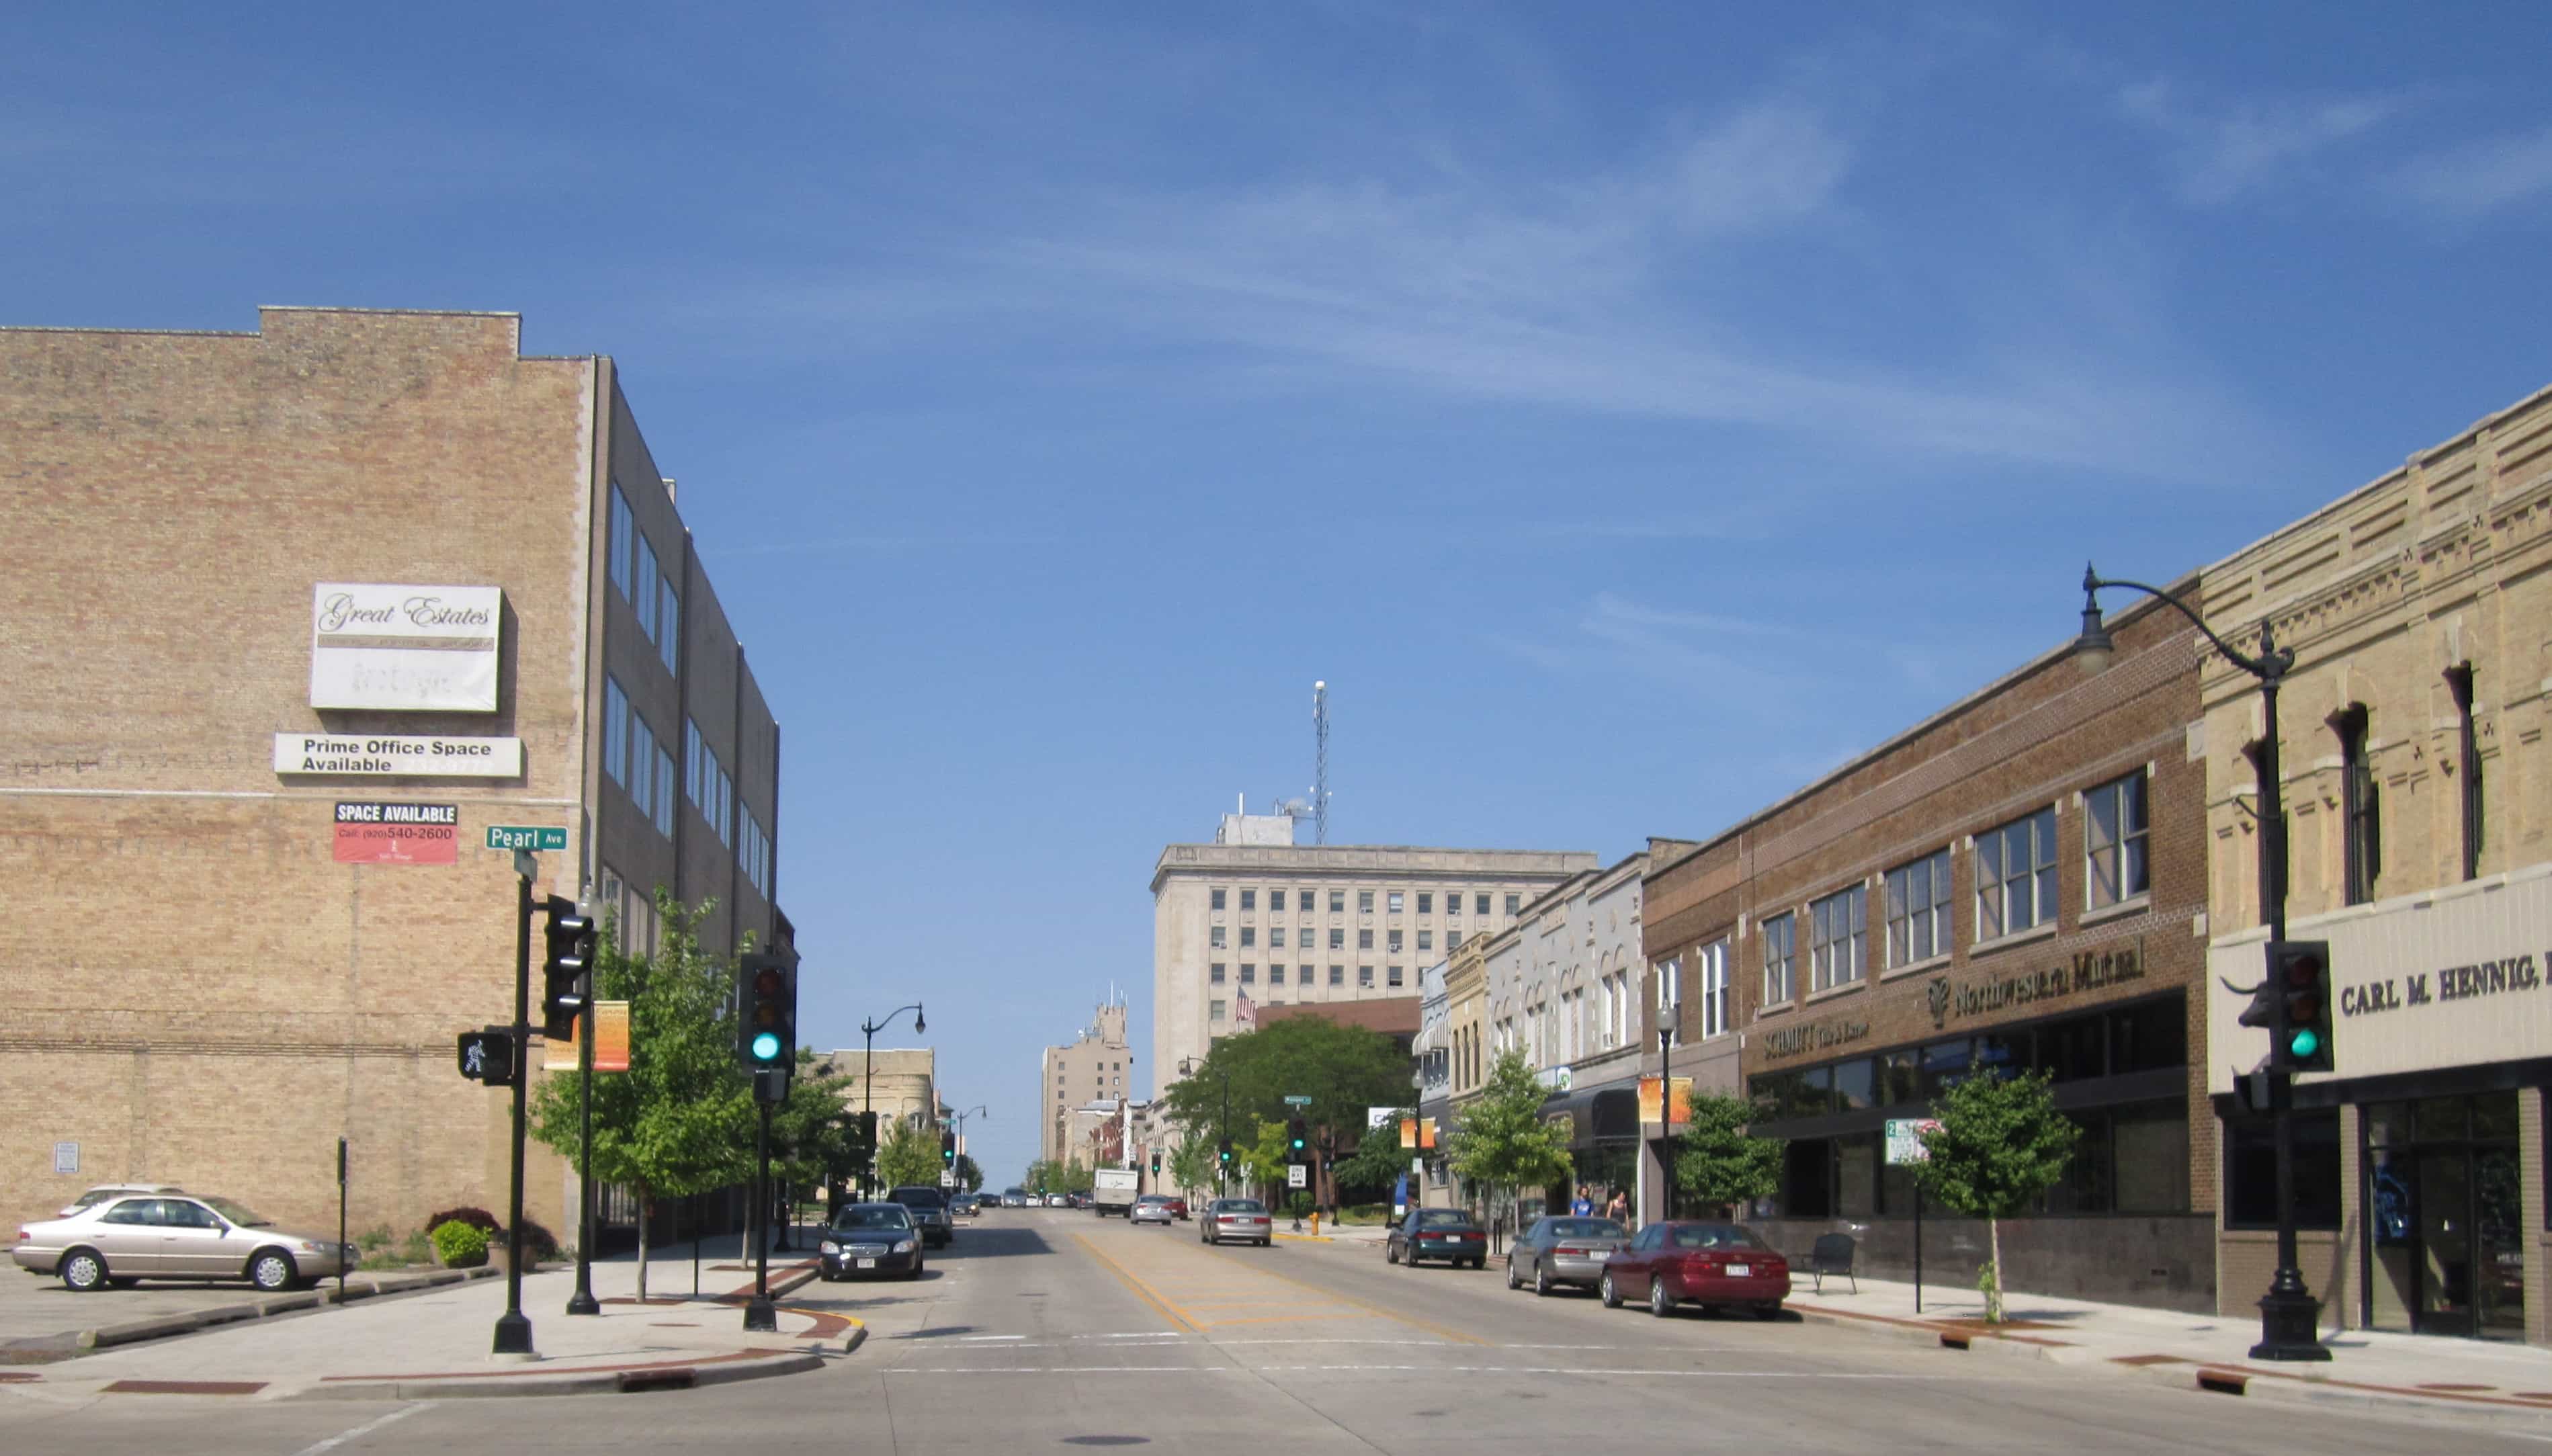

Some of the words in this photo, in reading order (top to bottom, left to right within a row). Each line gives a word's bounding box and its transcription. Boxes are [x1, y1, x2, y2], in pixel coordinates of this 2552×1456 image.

[318, 593, 395, 632] Great
[403, 597, 489, 628] Estates
[304, 739, 360, 753] Prime
[366, 740, 425, 754] Office
[431, 742, 492, 756] Space
[302, 758, 392, 772] Available
[338, 805, 380, 820] SPACE
[384, 806, 454, 822] AVAILABLE
[492, 828, 538, 847] Pearl
[546, 834, 562, 844] Ave
[2341, 980, 2400, 1017] CARL
[2407, 973, 2431, 1007] M.
[2439, 955, 2540, 1001] HENNIG,
